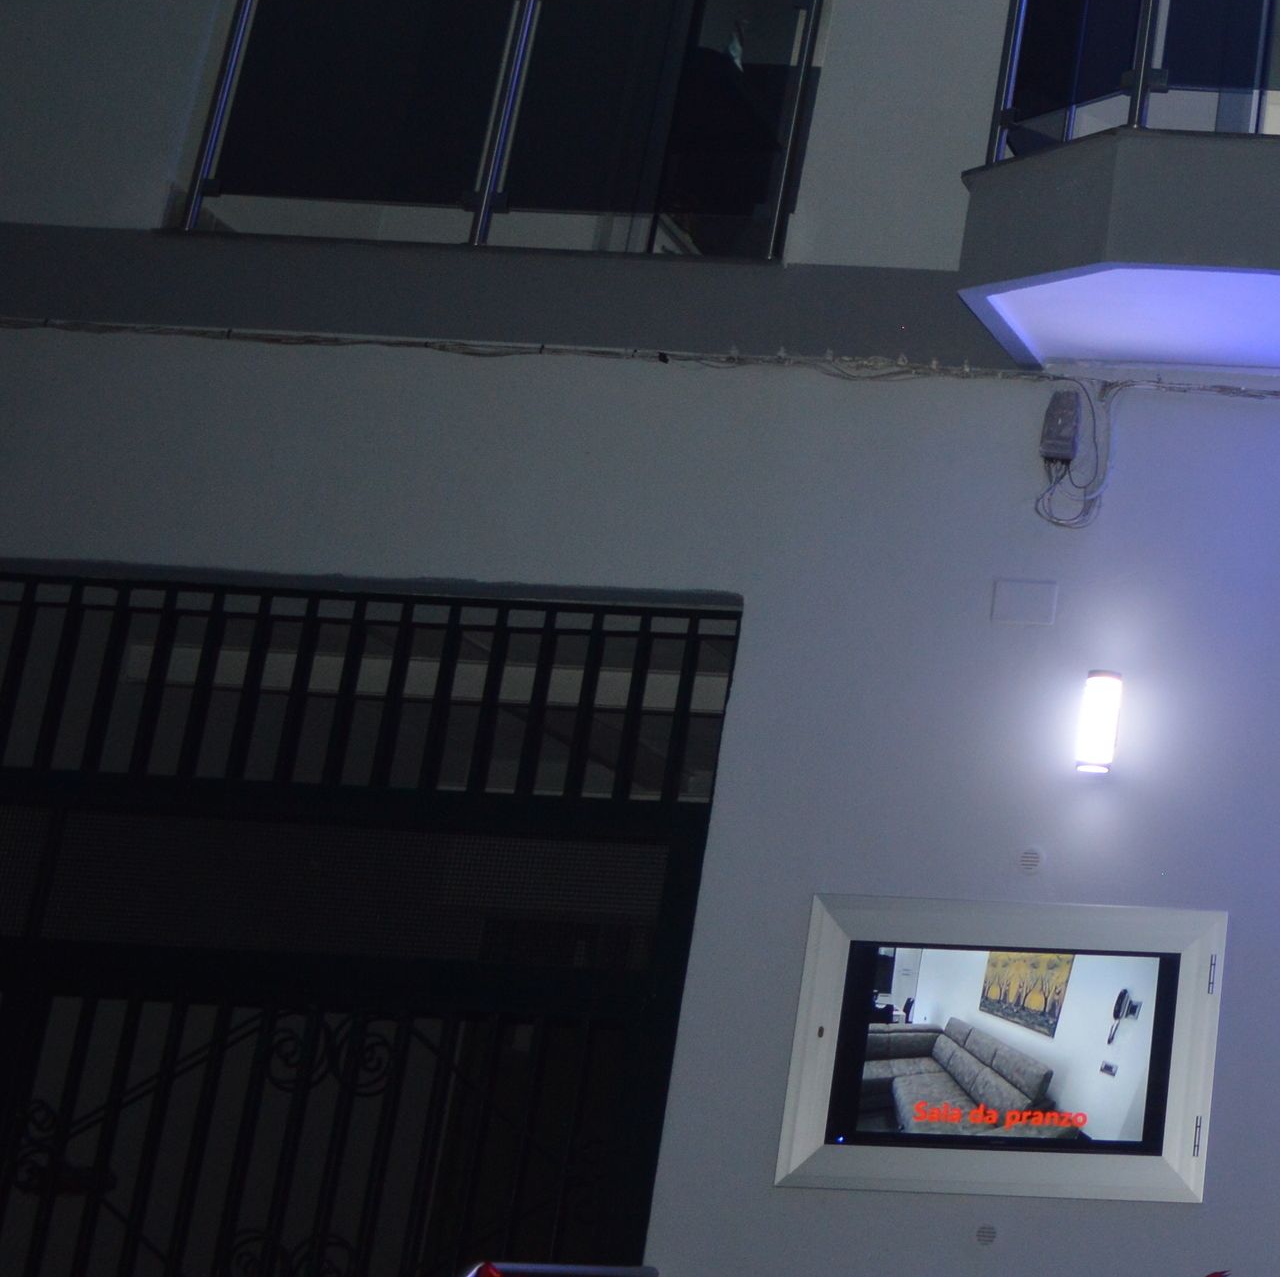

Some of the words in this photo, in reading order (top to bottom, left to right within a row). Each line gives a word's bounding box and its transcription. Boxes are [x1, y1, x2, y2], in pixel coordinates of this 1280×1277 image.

[913, 1100, 962, 1123] Sala
[968, 1104, 999, 1125] da
[1004, 1109, 1088, 1129] pranzo
